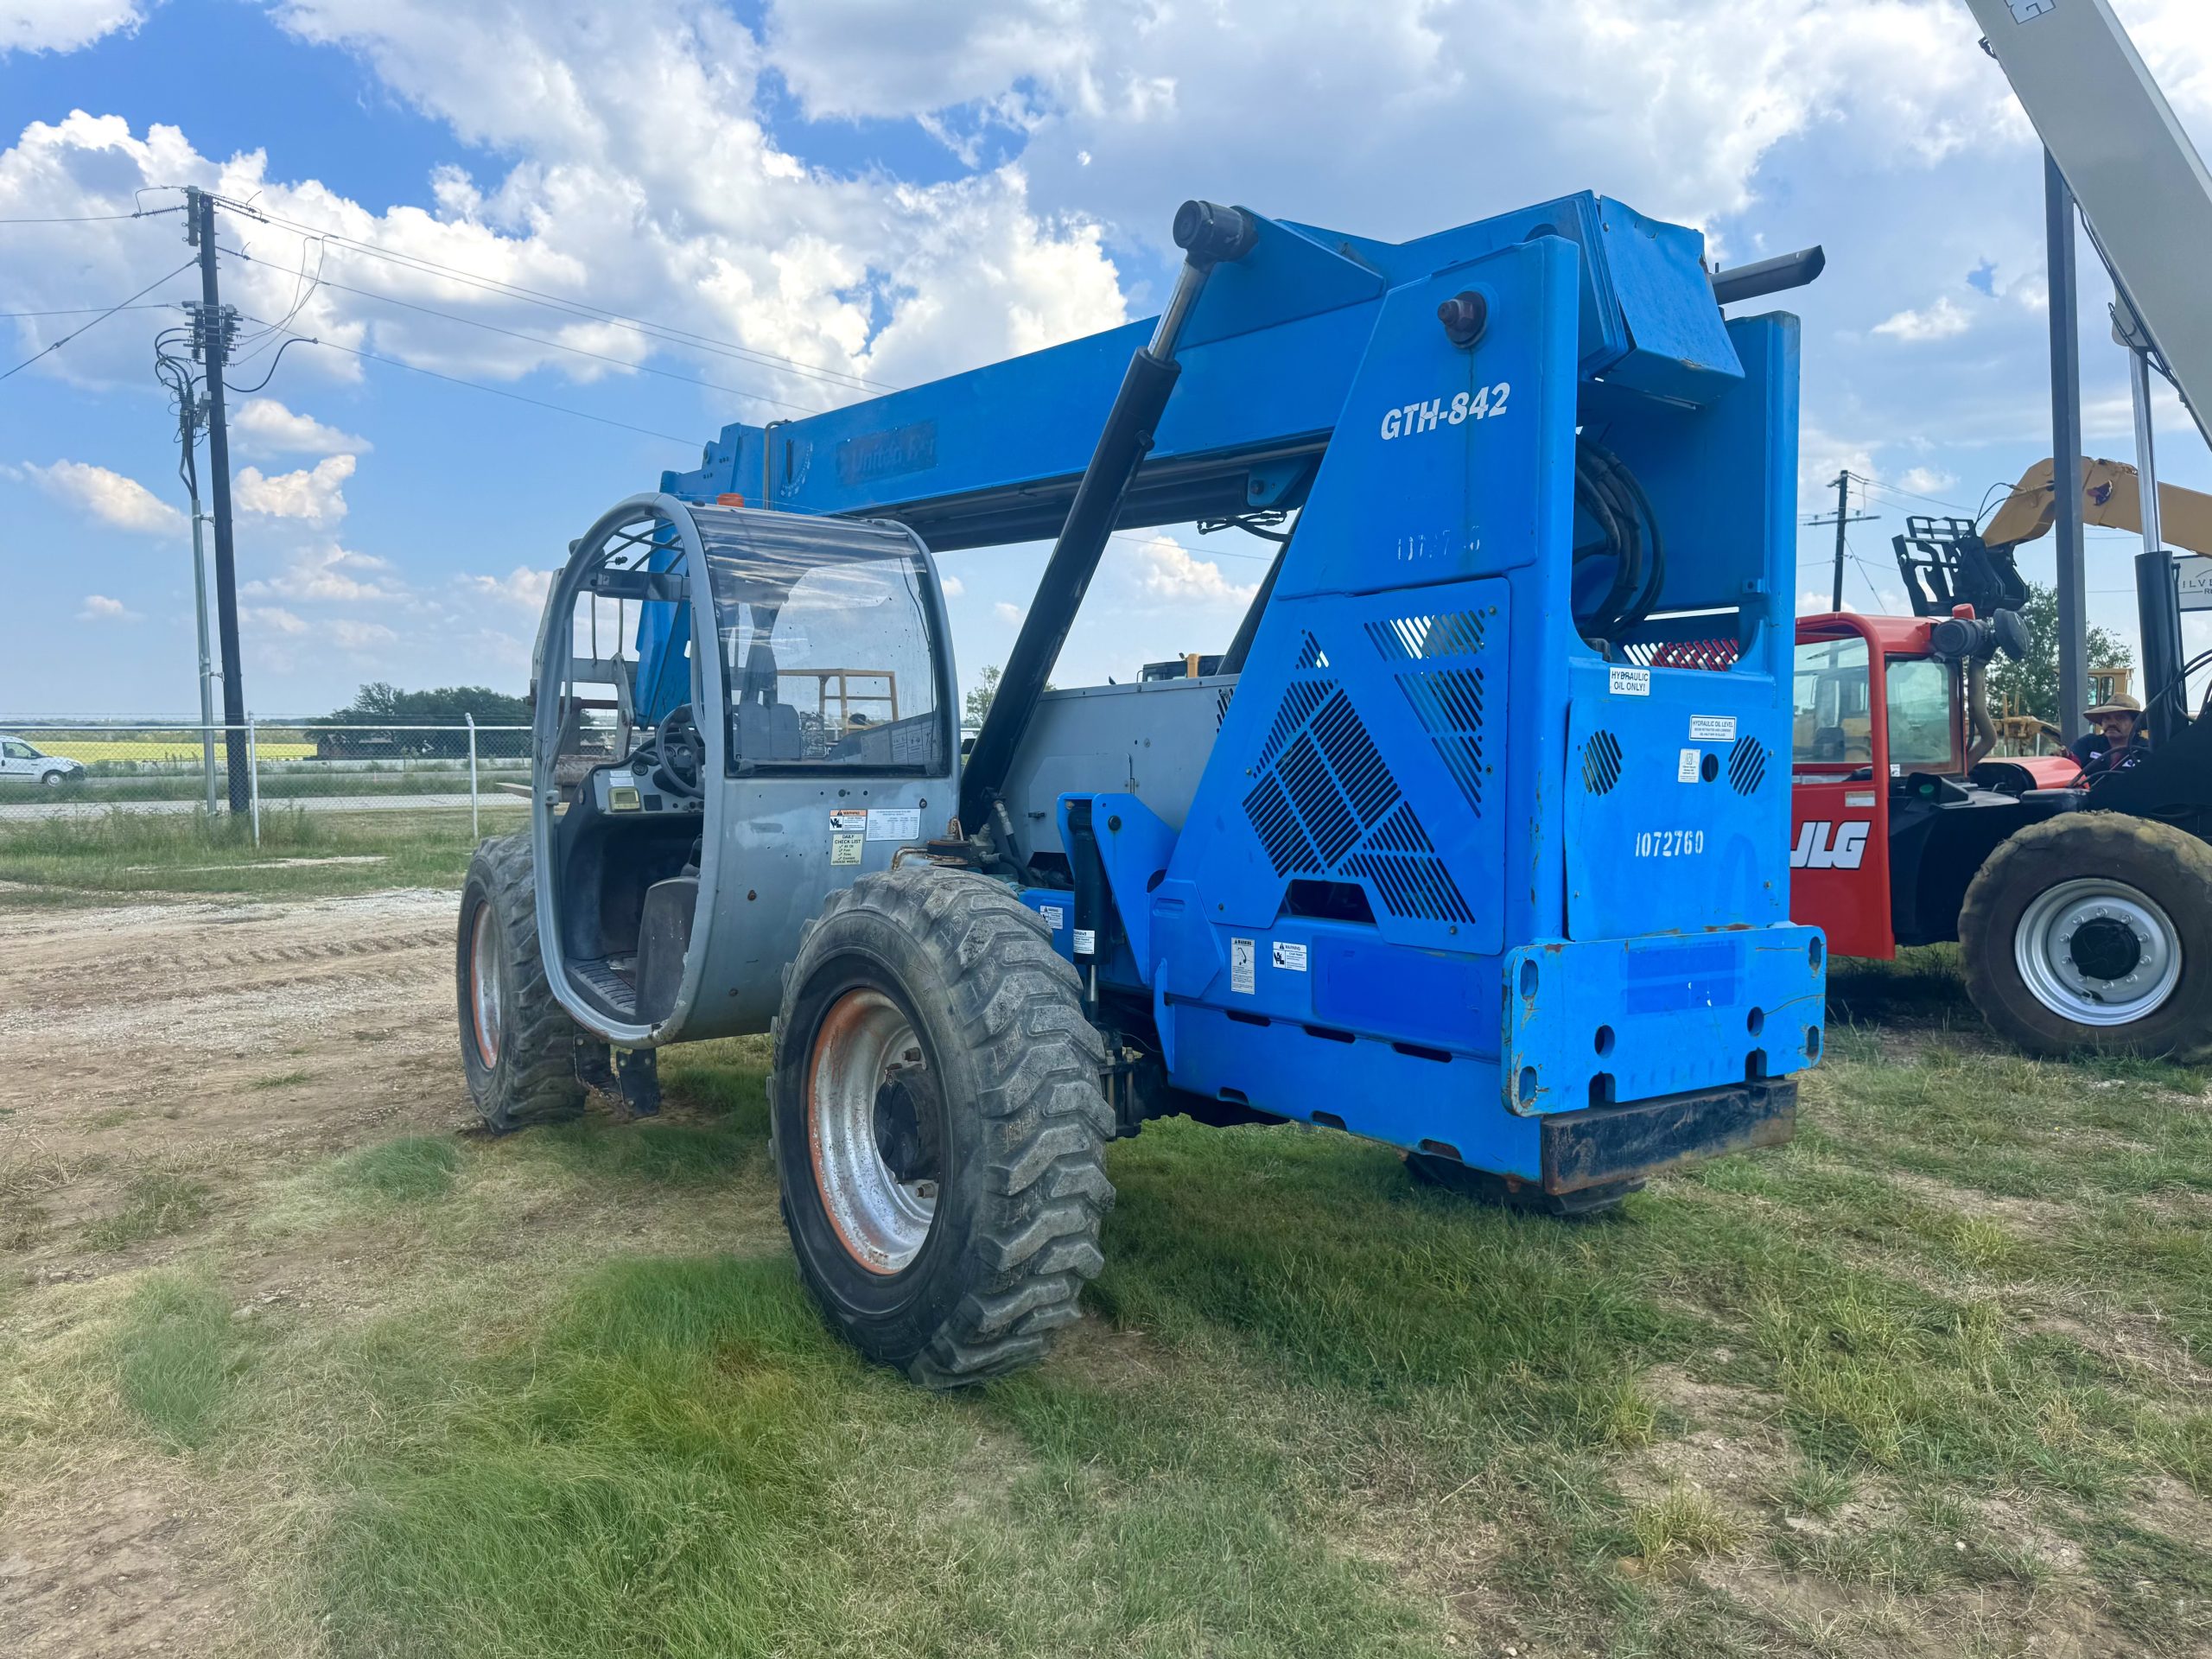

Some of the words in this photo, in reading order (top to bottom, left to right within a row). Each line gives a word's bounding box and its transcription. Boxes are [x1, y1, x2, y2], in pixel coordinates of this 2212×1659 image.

[1381, 382, 1510, 441] GTH-842
[1613, 681, 1624, 690] OIL
[1626, 683, 1646, 692] ONLY!
[1635, 830, 1704, 857] 1072760
[1790, 821, 1871, 869] JLG
